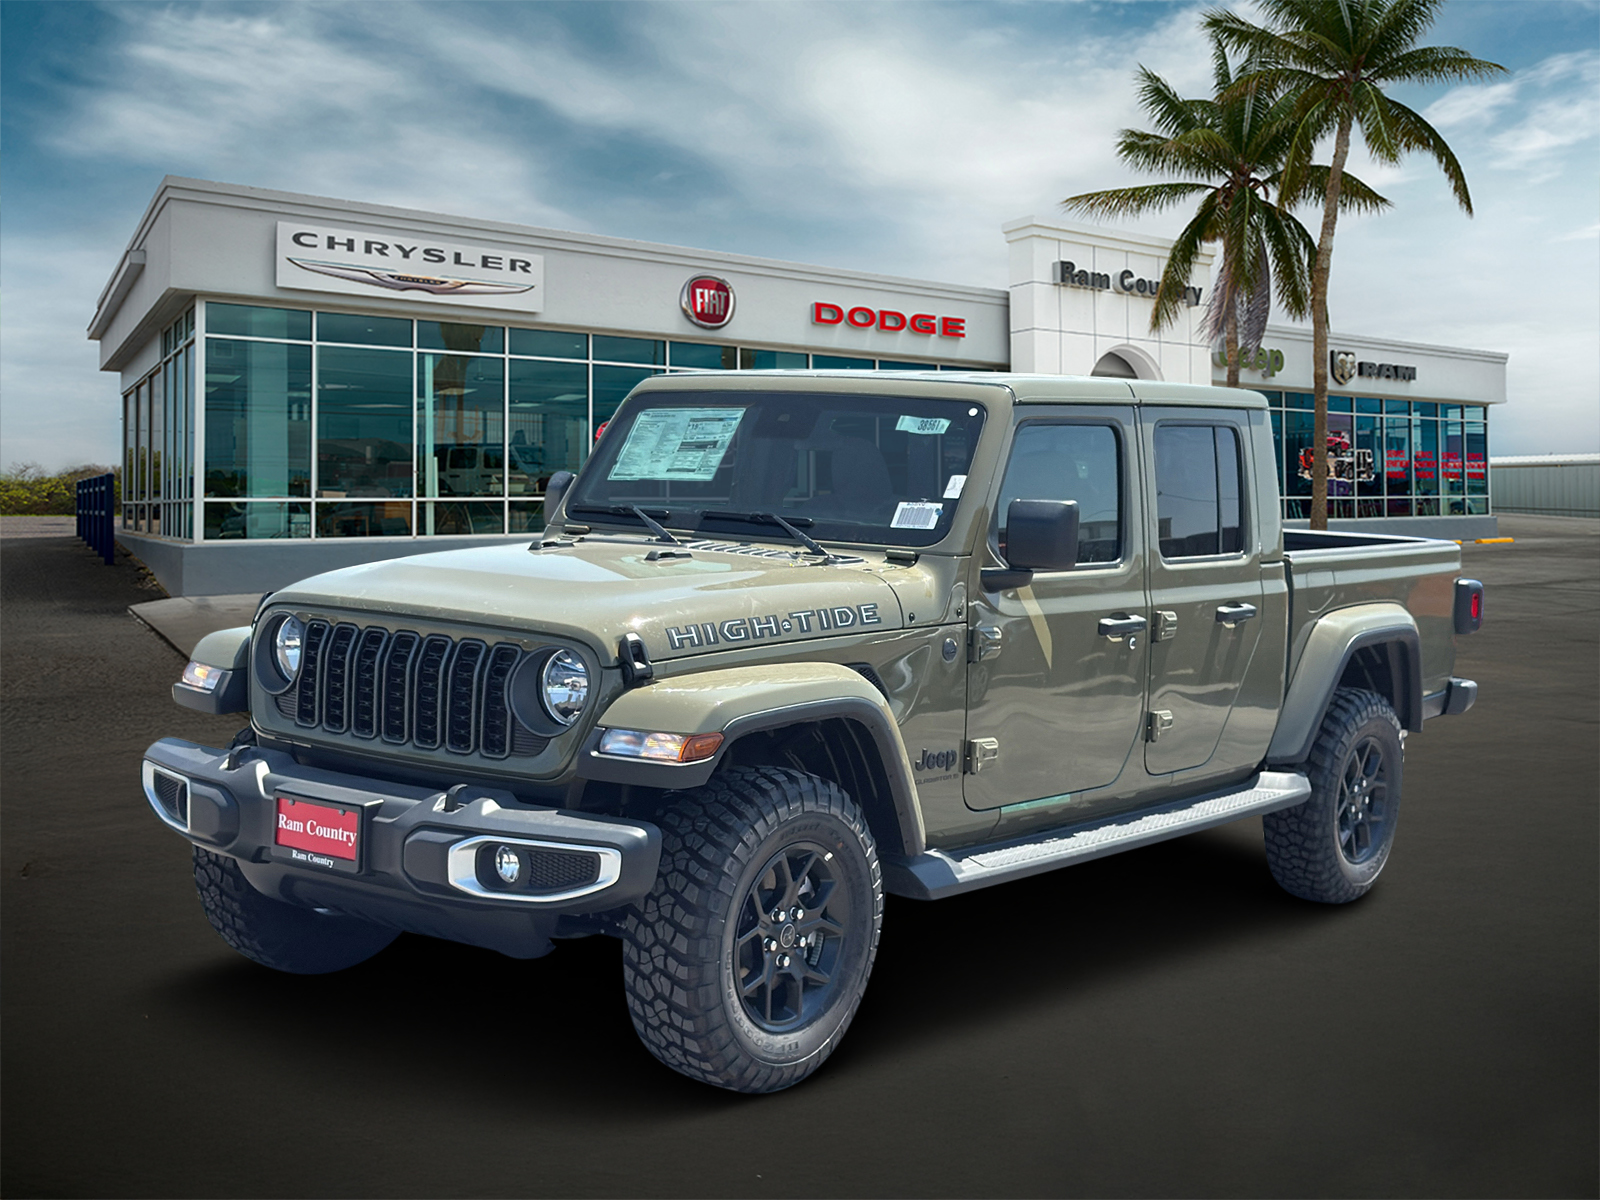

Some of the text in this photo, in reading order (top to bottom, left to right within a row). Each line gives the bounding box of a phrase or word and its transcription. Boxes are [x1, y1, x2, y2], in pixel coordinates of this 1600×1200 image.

[292, 231, 532, 274] CHRYSLER
[1057, 260, 1203, 307] Ram Coury
[695, 287, 728, 316] FIAT
[812, 300, 966, 338] DODGE
[1357, 361, 1416, 381] RAM
[665, 602, 881, 650] HIGH TIDE
[915, 748, 957, 772] Jeep
[278, 813, 357, 847] Ram Country
[291, 849, 335, 869] Ram Country
